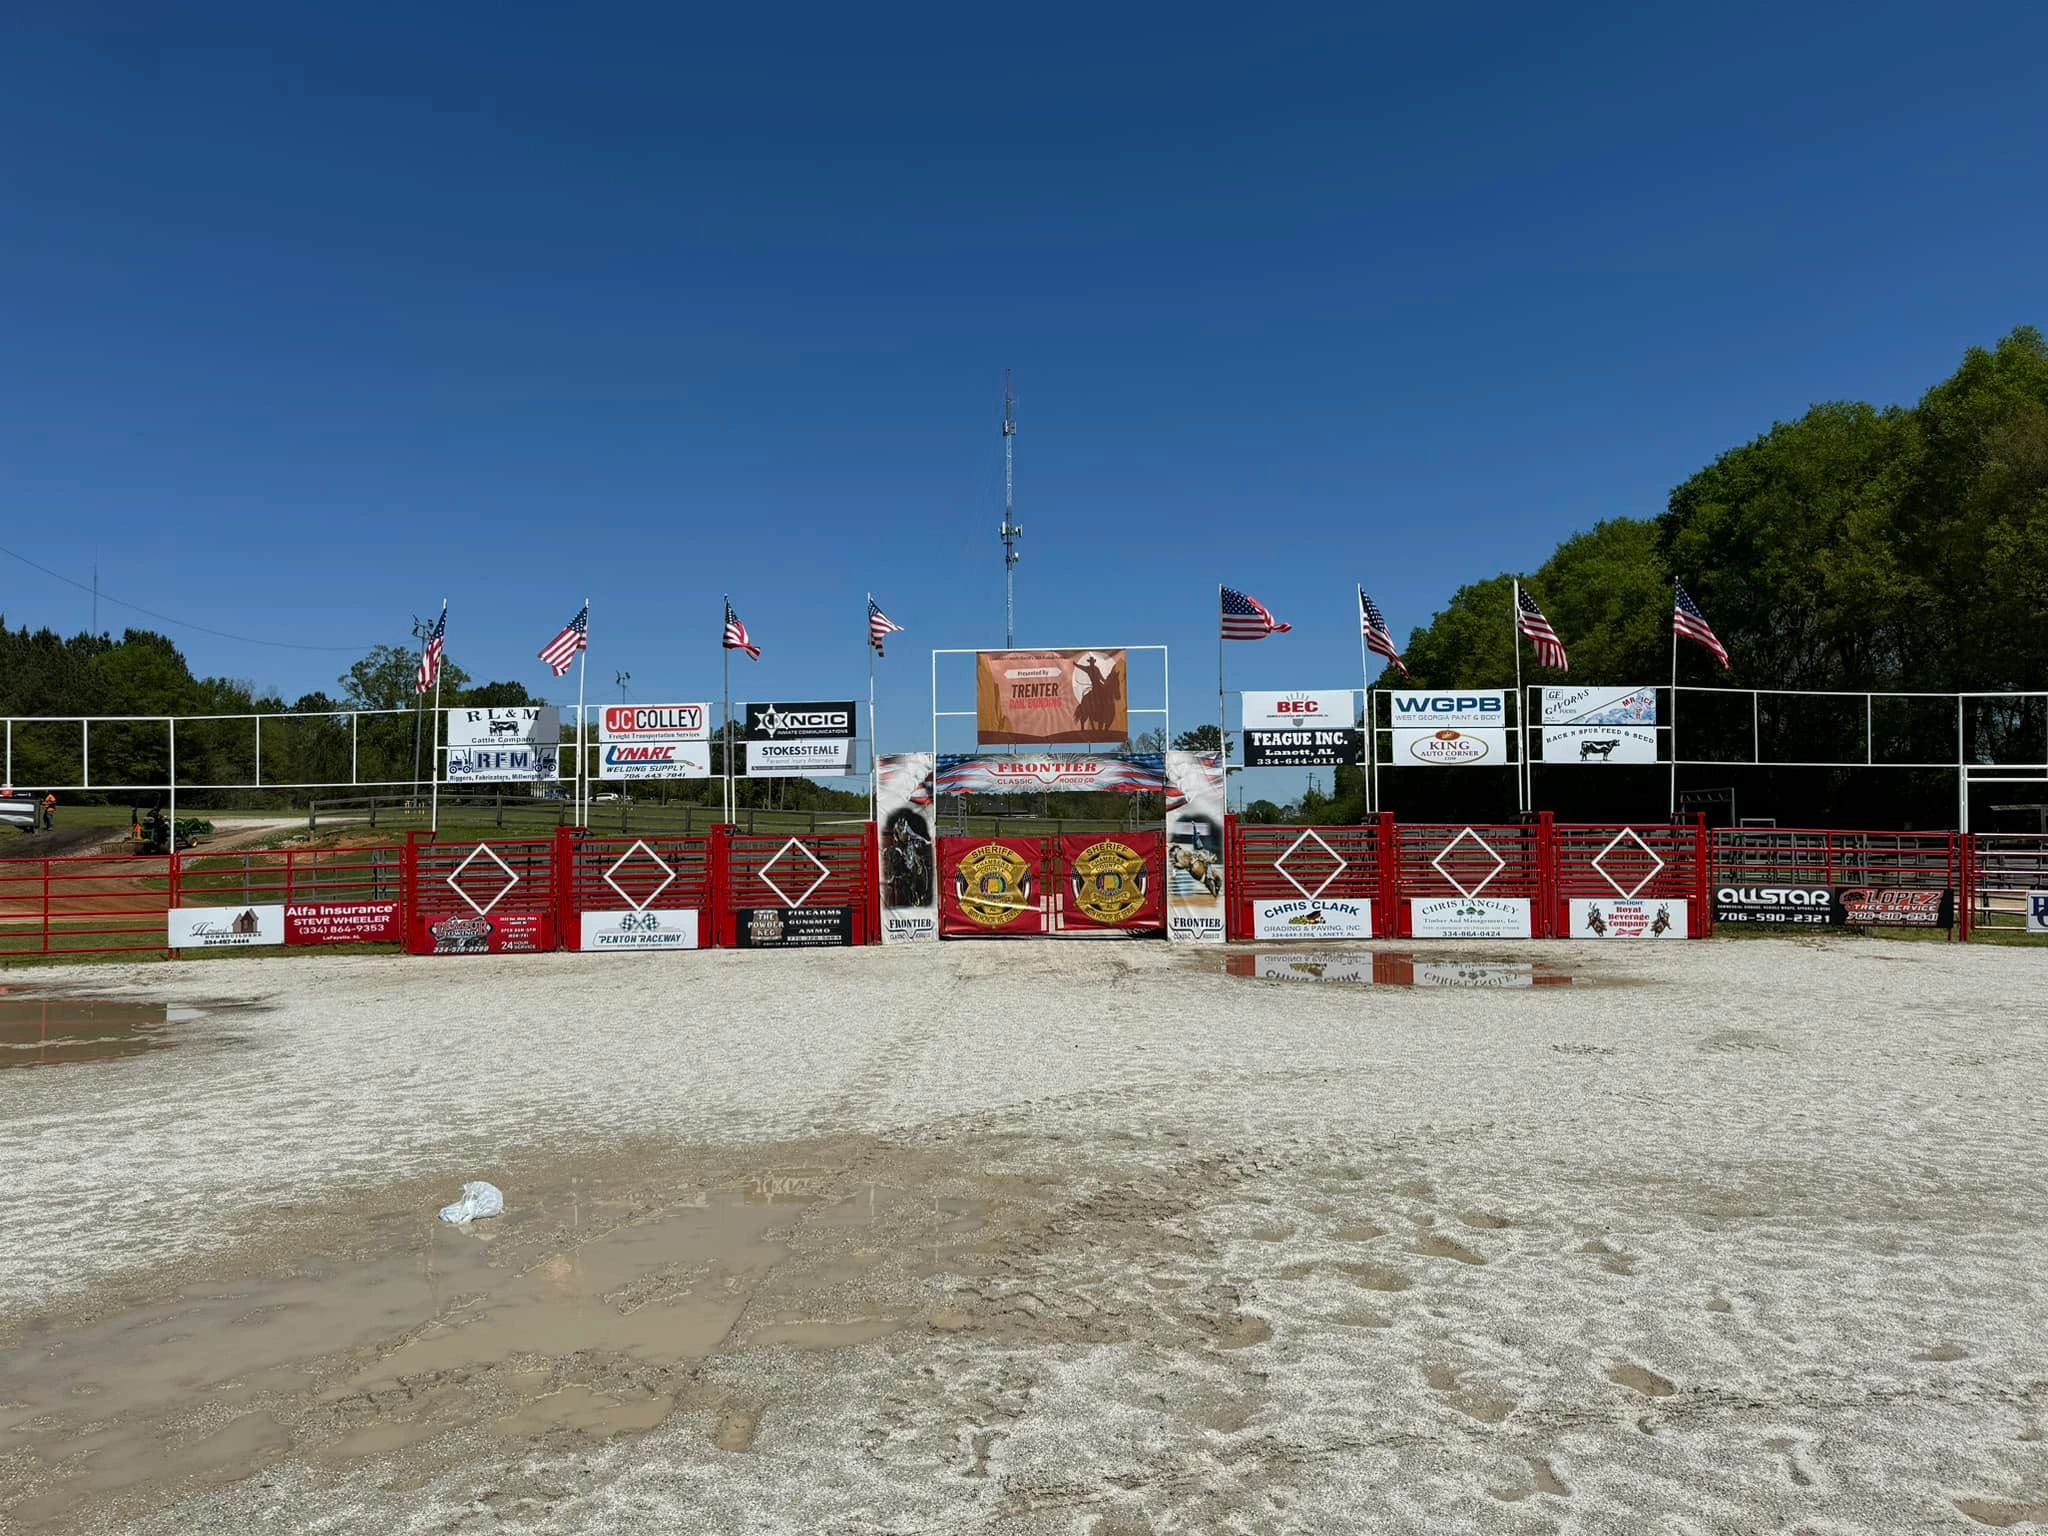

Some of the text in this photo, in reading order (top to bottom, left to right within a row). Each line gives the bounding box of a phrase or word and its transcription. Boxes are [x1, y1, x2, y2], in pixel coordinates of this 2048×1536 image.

[1011, 683, 1059, 698] TRENTER
[1277, 701, 1319, 713] BEC
[1395, 697, 1502, 713] WGPB
[1545, 689, 1590, 715] GIVORNS
[608, 709, 698, 730] JC COLLEY
[790, 714, 846, 727] NCIC
[498, 736, 536, 744] Company
[1251, 731, 1349, 746] TEAGUE INC.
[1633, 733, 1654, 744] SEED
[1429, 741, 1470, 750] KING
[477, 752, 528, 768] RFM
[1256, 757, 1344, 765] 334-644-0116
[606, 764, 686, 773] WELDING SUPPLY
[998, 762, 1097, 773] FRONTIER
[971, 847, 1014, 859] SHERIFF
[1087, 843, 1129, 856] SHERIFF
[1866, 890, 1941, 904] LOPEZ
[287, 905, 393, 916] Alfa Insurance
[1264, 901, 1360, 918] CHRIS CLARK
[1422, 899, 1519, 915] CHRIS LANGLEY
[293, 915, 390, 926] STEVE WHEELER
[1174, 917, 1221, 927] FRONTIER
[1719, 912, 1830, 923] 706-590-2321
[299, 924, 385, 934] (334) 864-9353
[748, 921, 784, 929] POWDER
[889, 919, 932, 928] FRONTIER
[1609, 920, 1649, 928] Company
[599, 934, 681, 944] PENTON RACEWAY
[501, 941, 513, 950] 24
